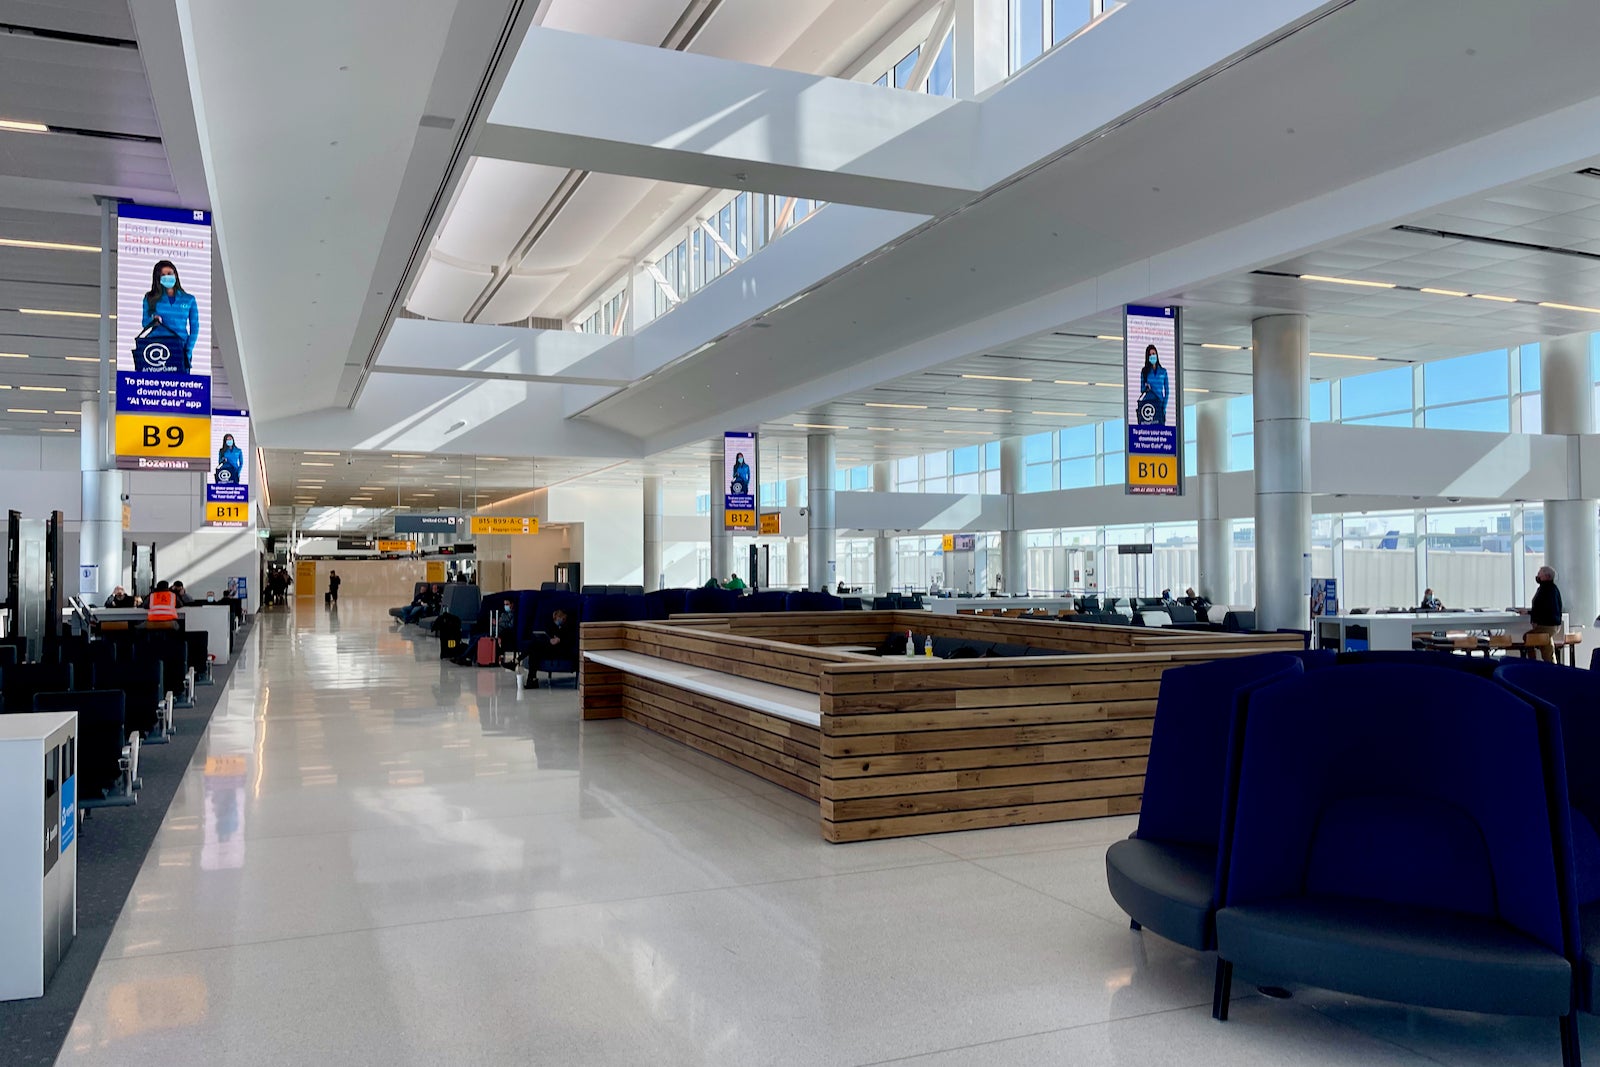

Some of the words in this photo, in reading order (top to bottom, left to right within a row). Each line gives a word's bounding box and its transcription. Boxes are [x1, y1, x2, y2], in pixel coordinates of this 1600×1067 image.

[155, 226, 182, 236] fresh
[124, 233, 150, 244] Eats
[152, 236, 204, 249] Delivered
[124, 244, 149, 255] right
[153, 247, 164, 255] to
[166, 249, 189, 257] you!
[125, 377, 135, 385] To
[136, 378, 159, 387] place
[160, 380, 179, 388] your
[180, 381, 203, 389] order,
[137, 388, 177, 397] download
[179, 389, 192, 398] the
[141, 397, 160, 406] Your
[143, 425, 185, 448] B9
[139, 458, 189, 469] Bozeman
[1138, 462, 1168, 479] B10
[217, 507, 239, 517] B11
[731, 513, 749, 523] B12
